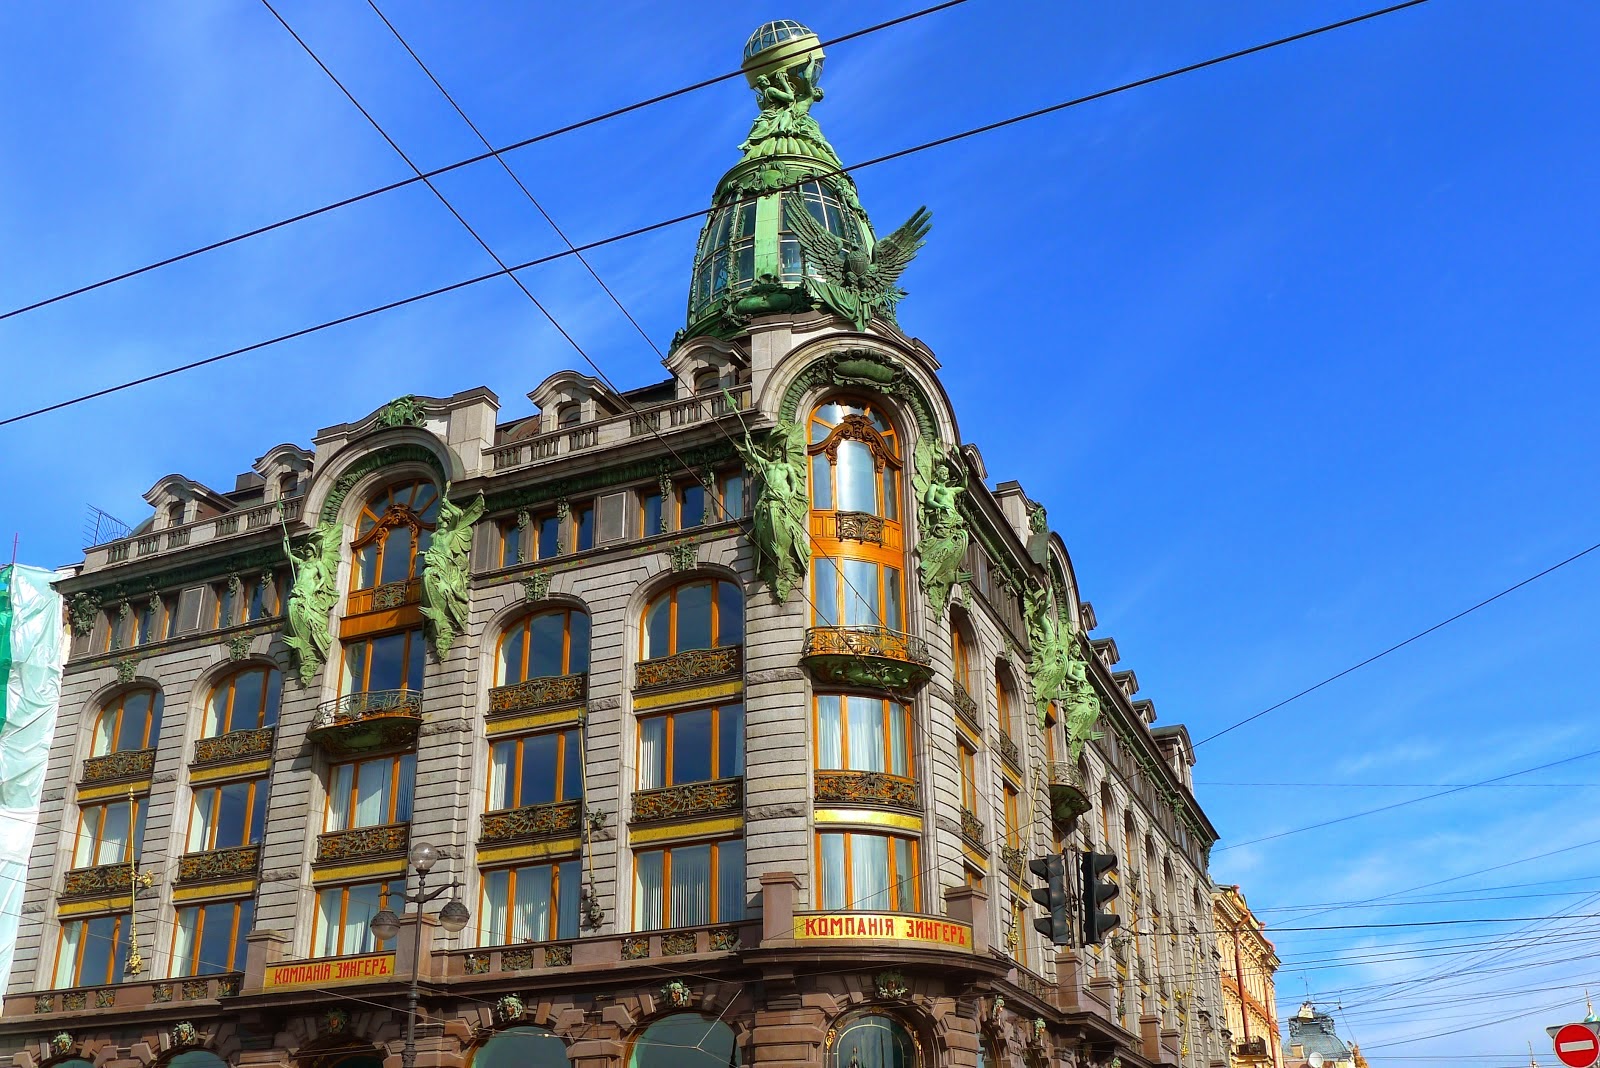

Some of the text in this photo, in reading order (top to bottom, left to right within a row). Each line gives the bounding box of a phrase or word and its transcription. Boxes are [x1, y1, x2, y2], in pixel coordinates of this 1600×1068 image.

[805, 918, 965, 945] КОМПАНІЯ ЗИНГЕРЪ
[274, 963, 331, 985] КОМПАНІЯ
